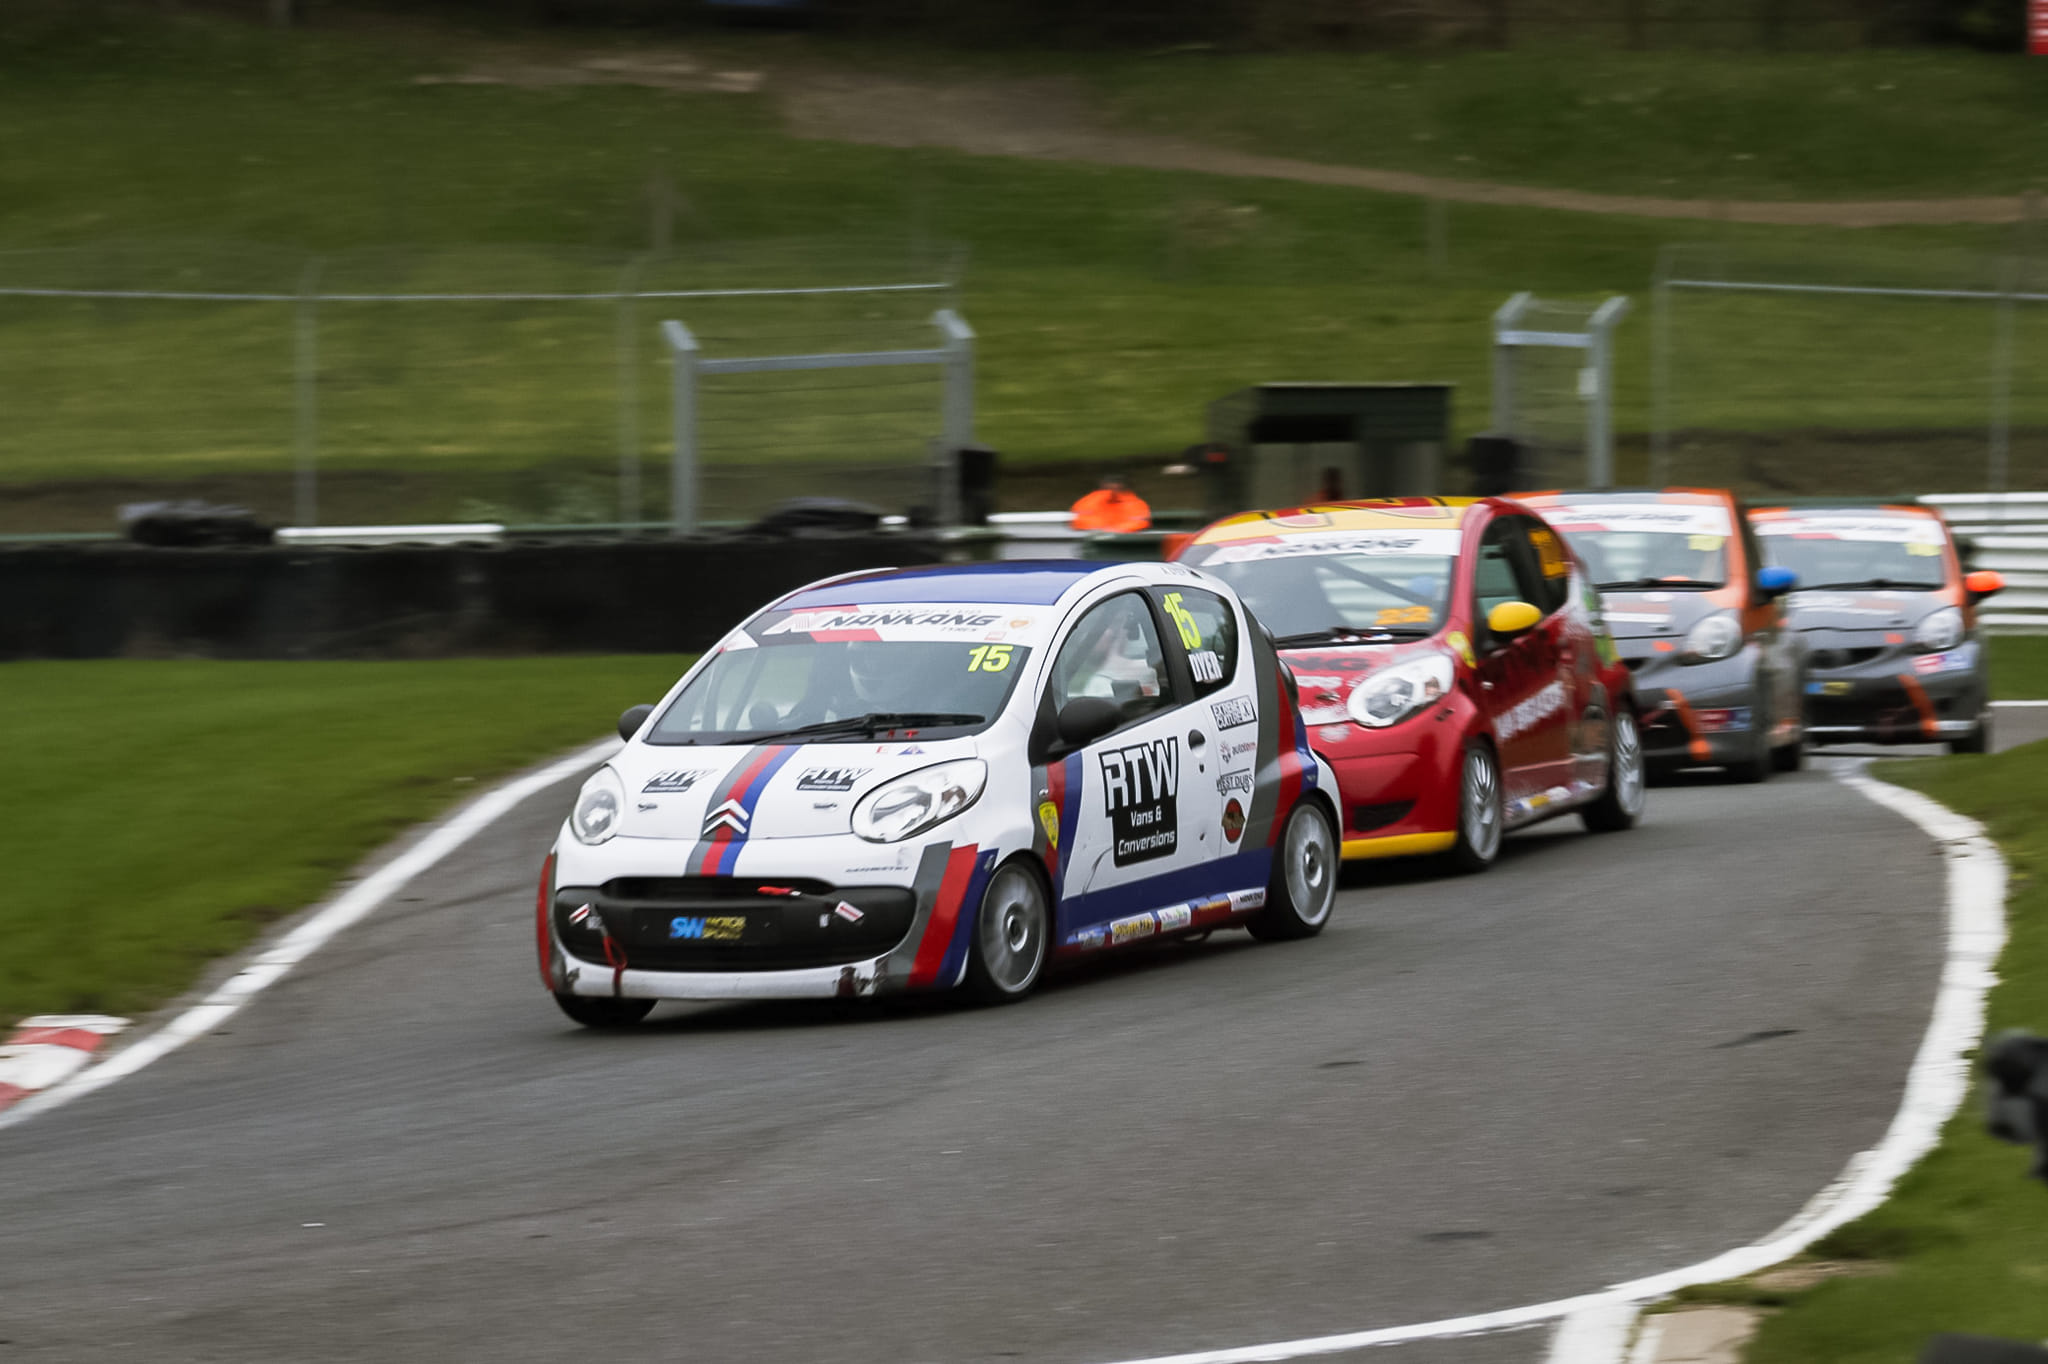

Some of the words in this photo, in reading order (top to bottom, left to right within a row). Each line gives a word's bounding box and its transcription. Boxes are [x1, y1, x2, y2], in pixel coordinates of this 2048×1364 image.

[822, 613, 1002, 628] NANKANG
[1163, 592, 1202, 650] 15
[967, 645, 1014, 672] 15
[1099, 737, 1178, 815] RTW
[1130, 810, 1154, 828] Vans
[1155, 805, 1162, 822] &
[1118, 829, 1175, 857] Conversions
[669, 916, 707, 940] SW
